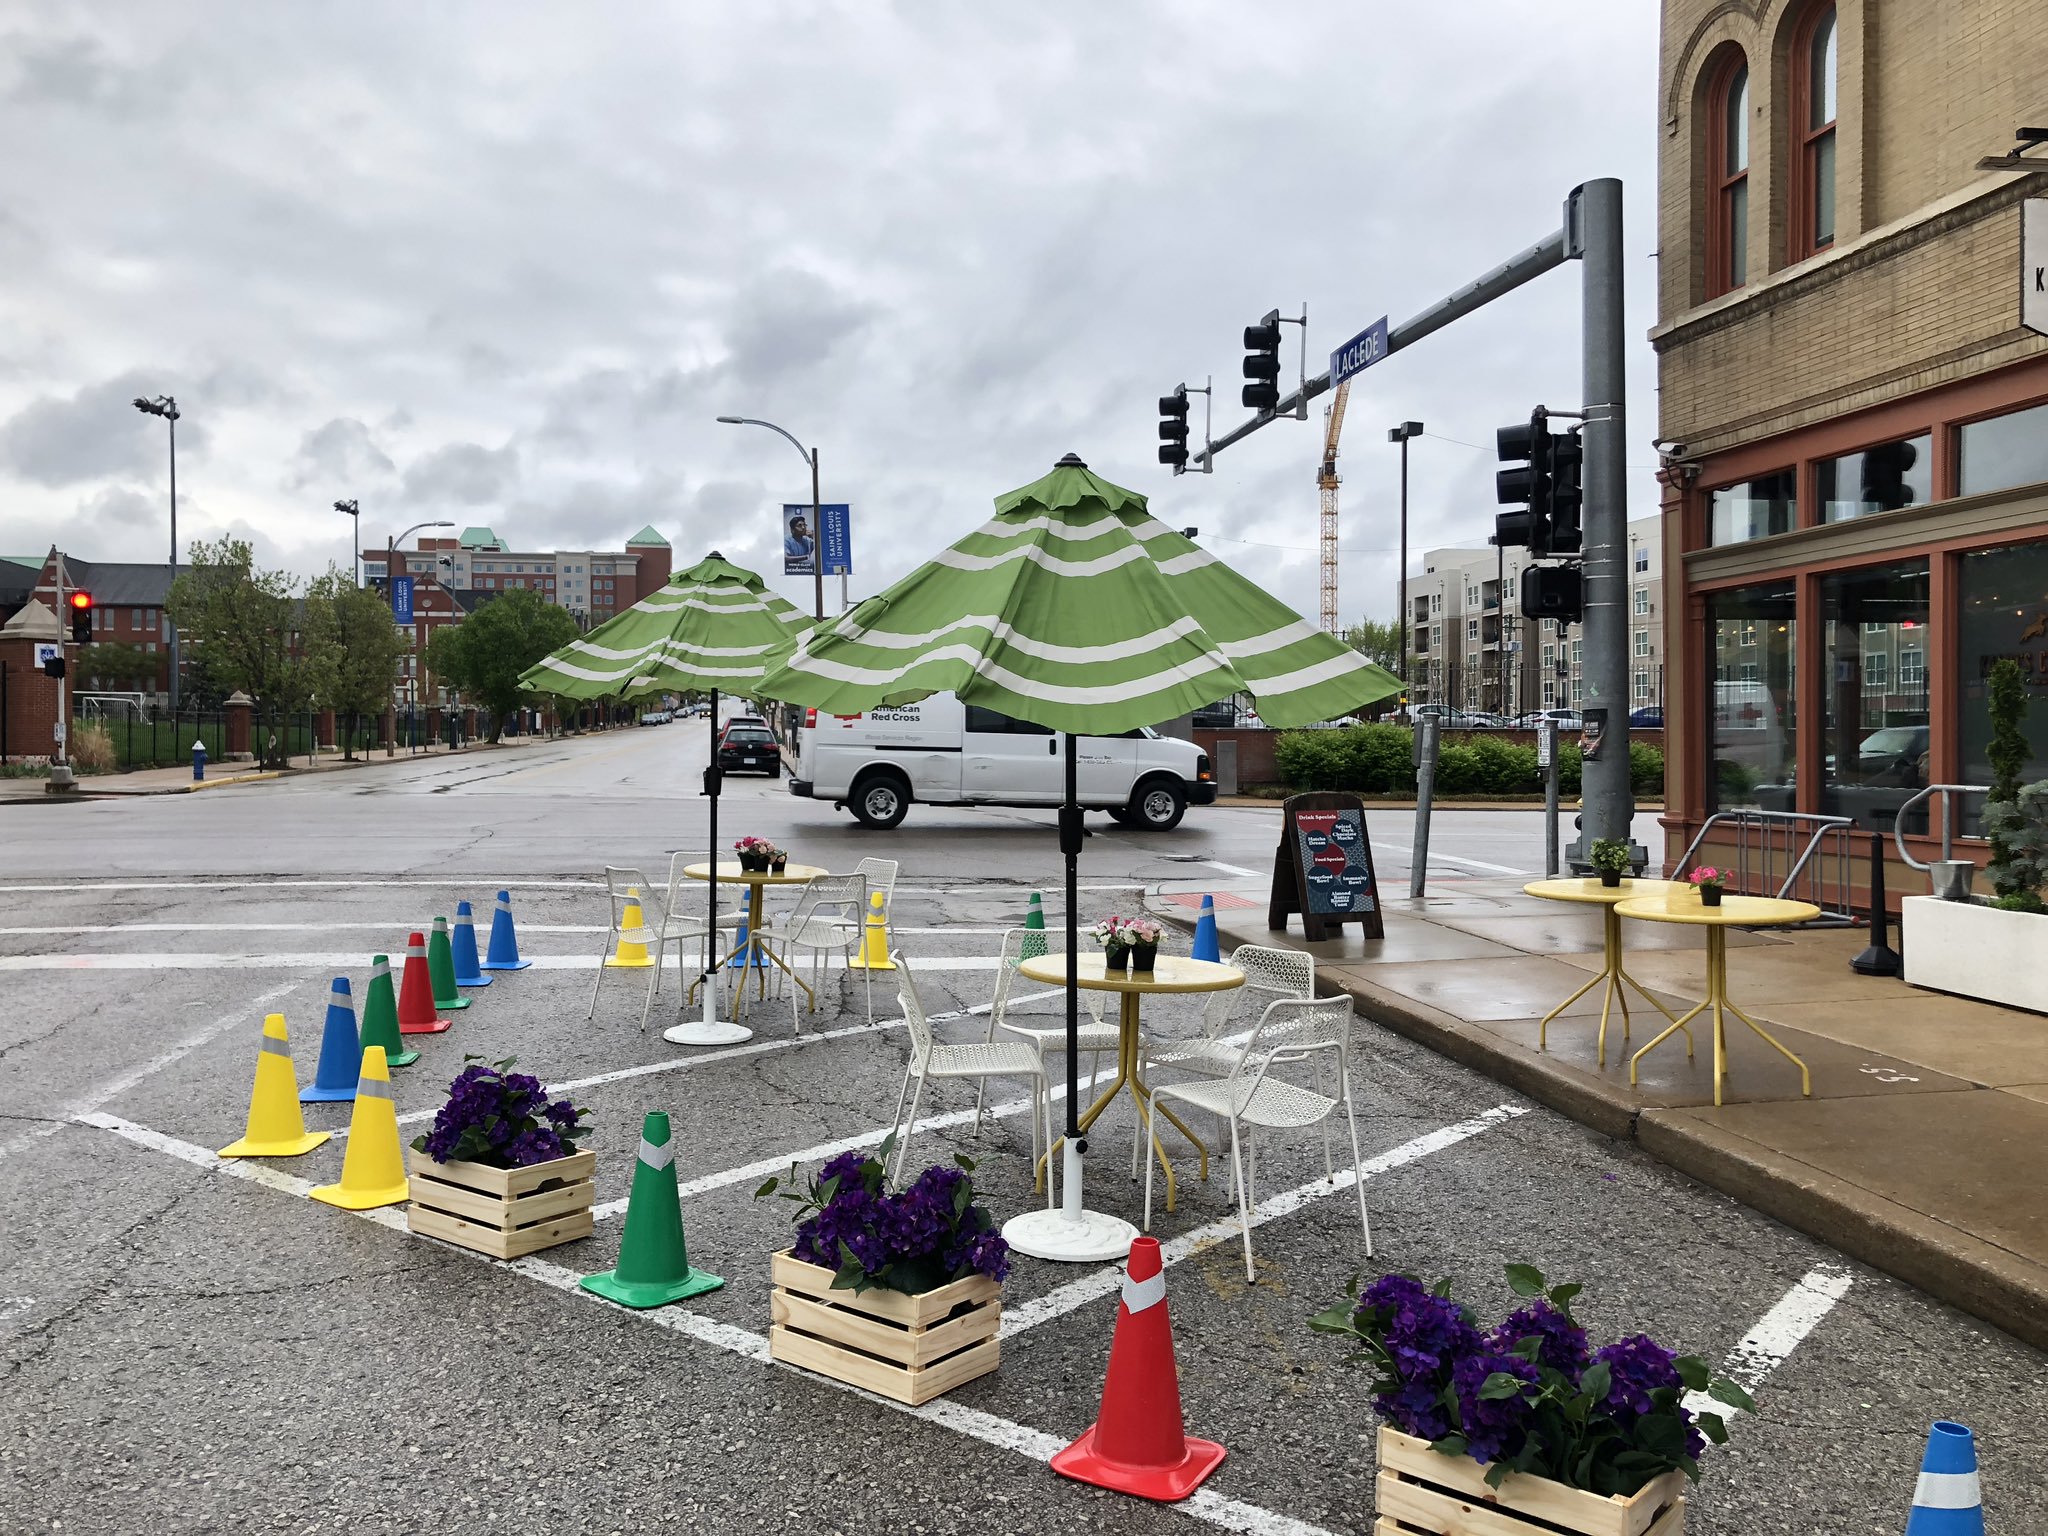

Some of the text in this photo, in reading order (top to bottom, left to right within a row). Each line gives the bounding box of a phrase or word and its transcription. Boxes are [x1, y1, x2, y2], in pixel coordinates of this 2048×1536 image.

[1336, 330, 1379, 379] LACLEDE
[871, 713, 920, 722] Red Cross
